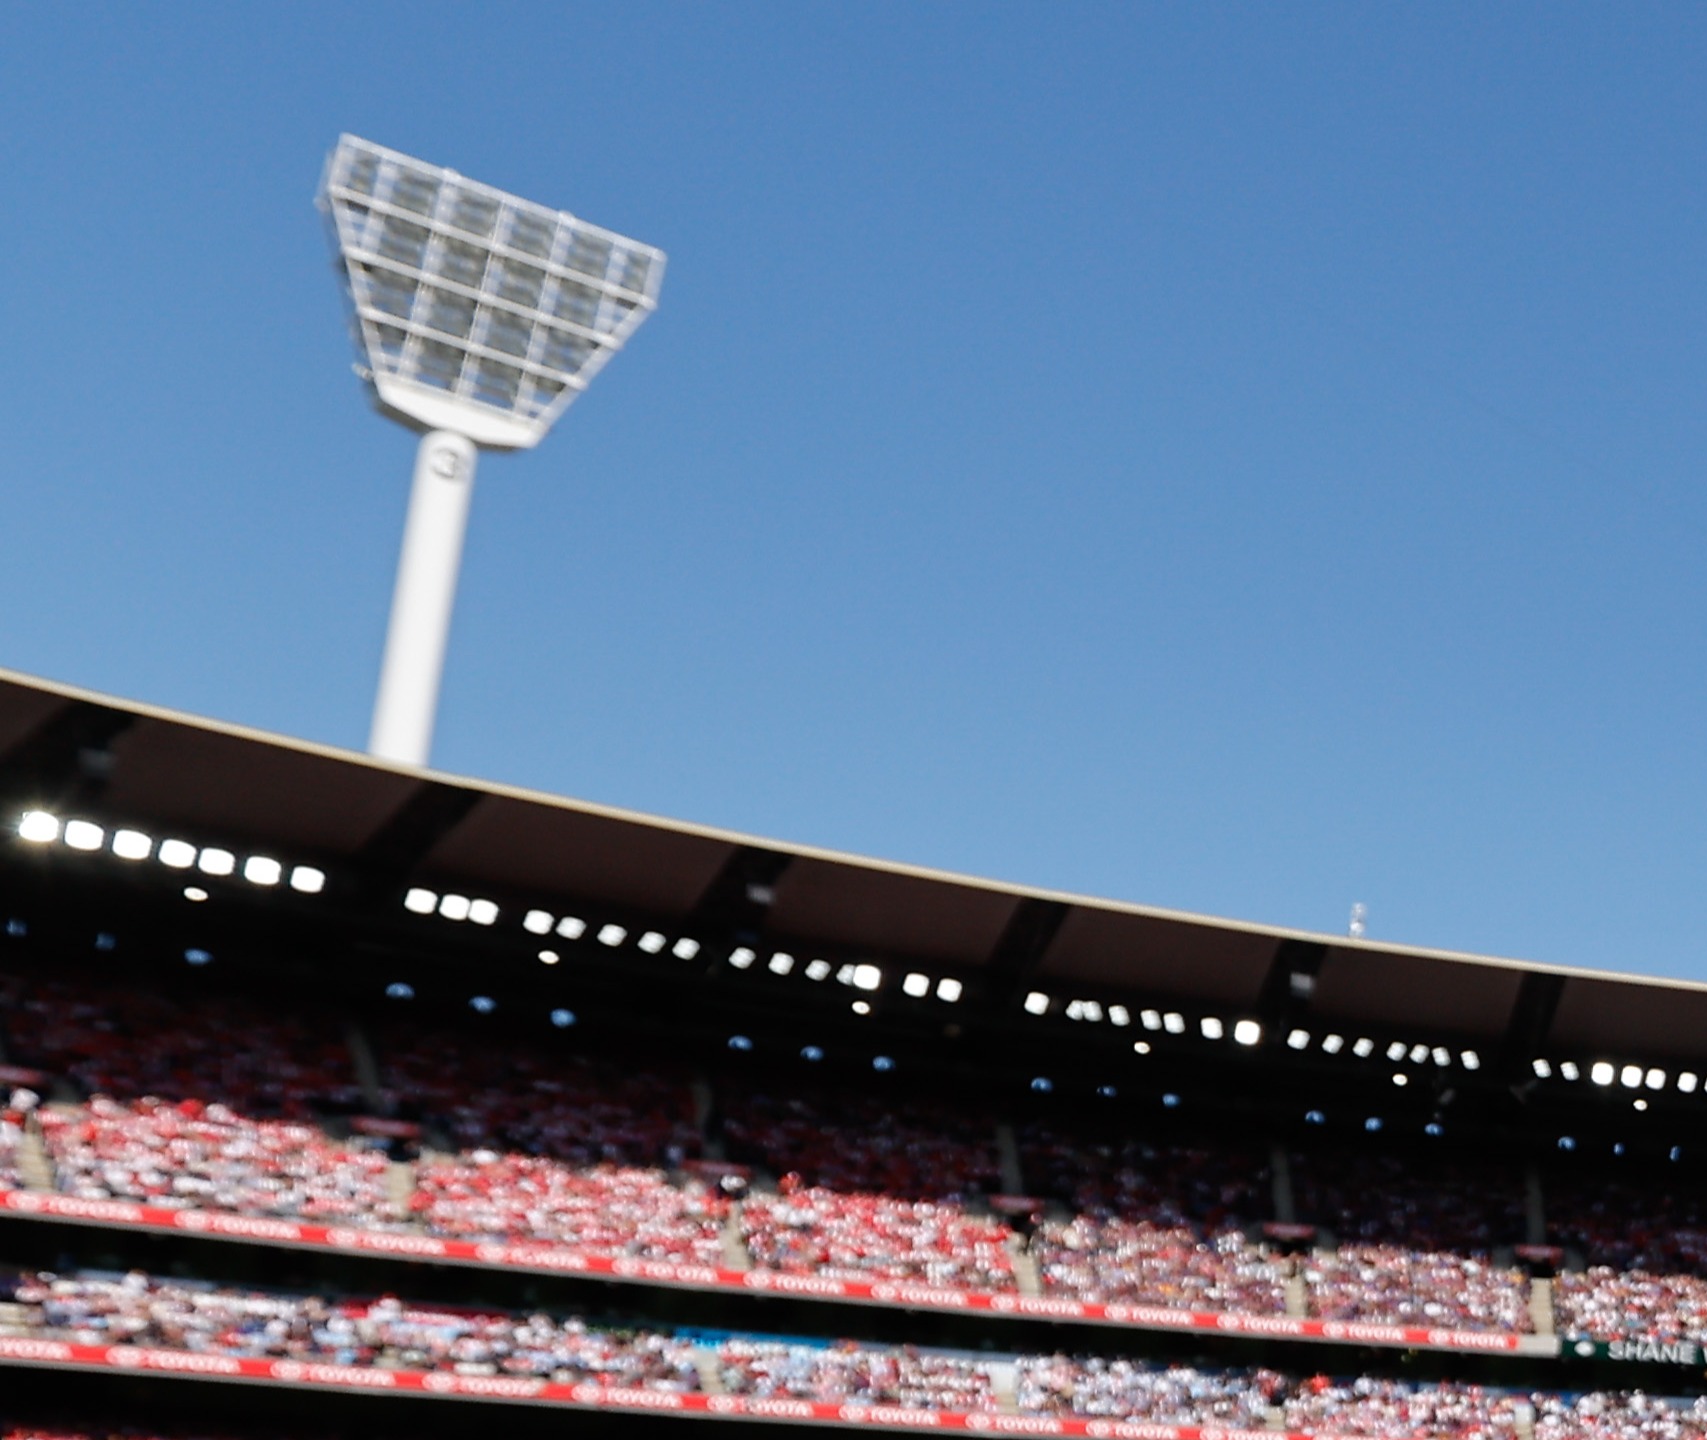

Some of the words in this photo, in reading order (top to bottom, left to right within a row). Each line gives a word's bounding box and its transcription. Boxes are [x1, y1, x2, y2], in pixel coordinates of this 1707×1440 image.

[894, 1286, 963, 1305] TOYOTA
[1132, 1307, 1194, 1325] TOYOTA
[1243, 1317, 1302, 1334] TOYOTA
[1347, 1324, 1404, 1341] TOYOTA
[1453, 1332, 1507, 1348] TOYOTA
[1607, 1340, 1694, 1365] SHANE
[607, 1387, 680, 1408] TOYOTA
[871, 1408, 939, 1426] TOYOTA
[995, 1416, 1059, 1433] TOYOTA
[1115, 1423, 1179, 1440] TOYOTA
